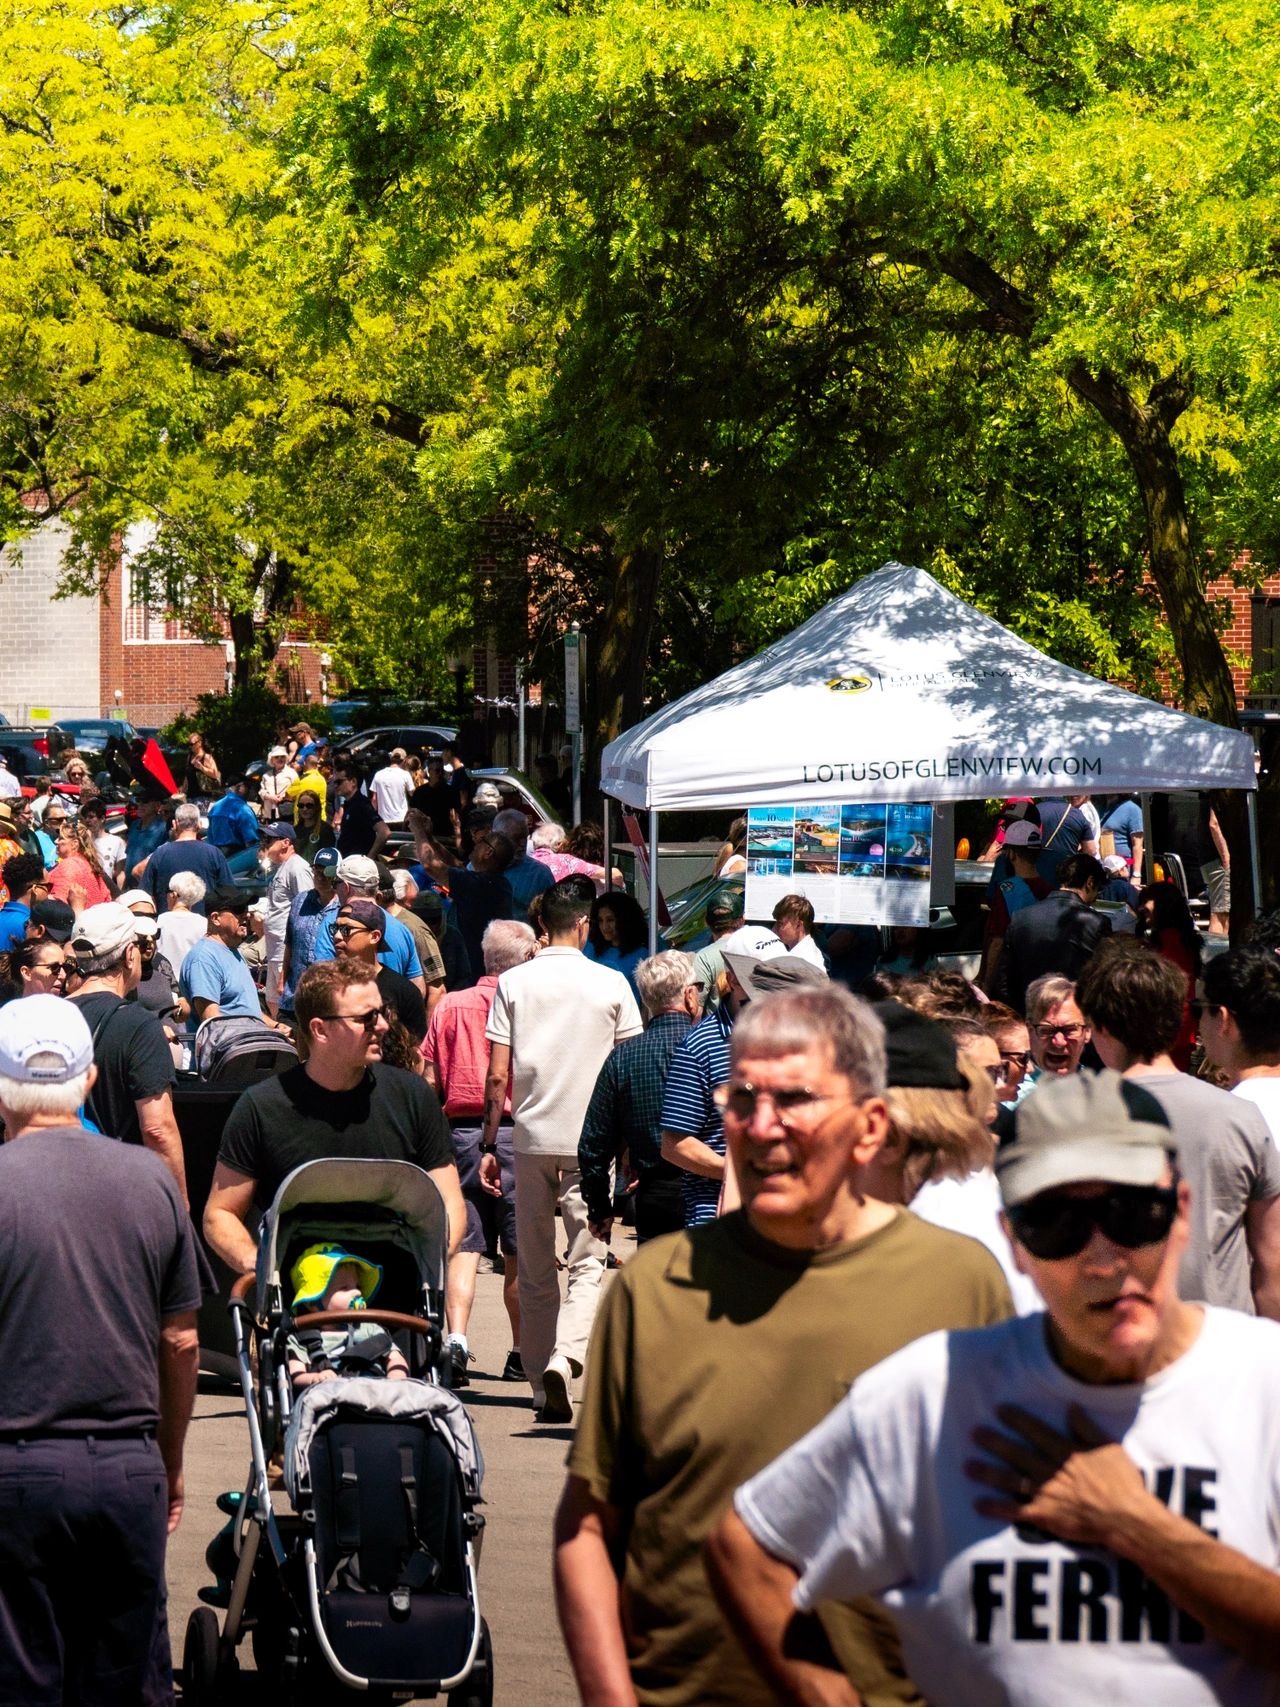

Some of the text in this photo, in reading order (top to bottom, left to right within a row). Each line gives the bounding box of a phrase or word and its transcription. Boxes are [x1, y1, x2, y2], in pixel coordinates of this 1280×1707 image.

[890, 670, 1040, 682] LOTUS GLENVIEW
[803, 757, 1102, 784] LOTUSOFGLENVIEW.COM
